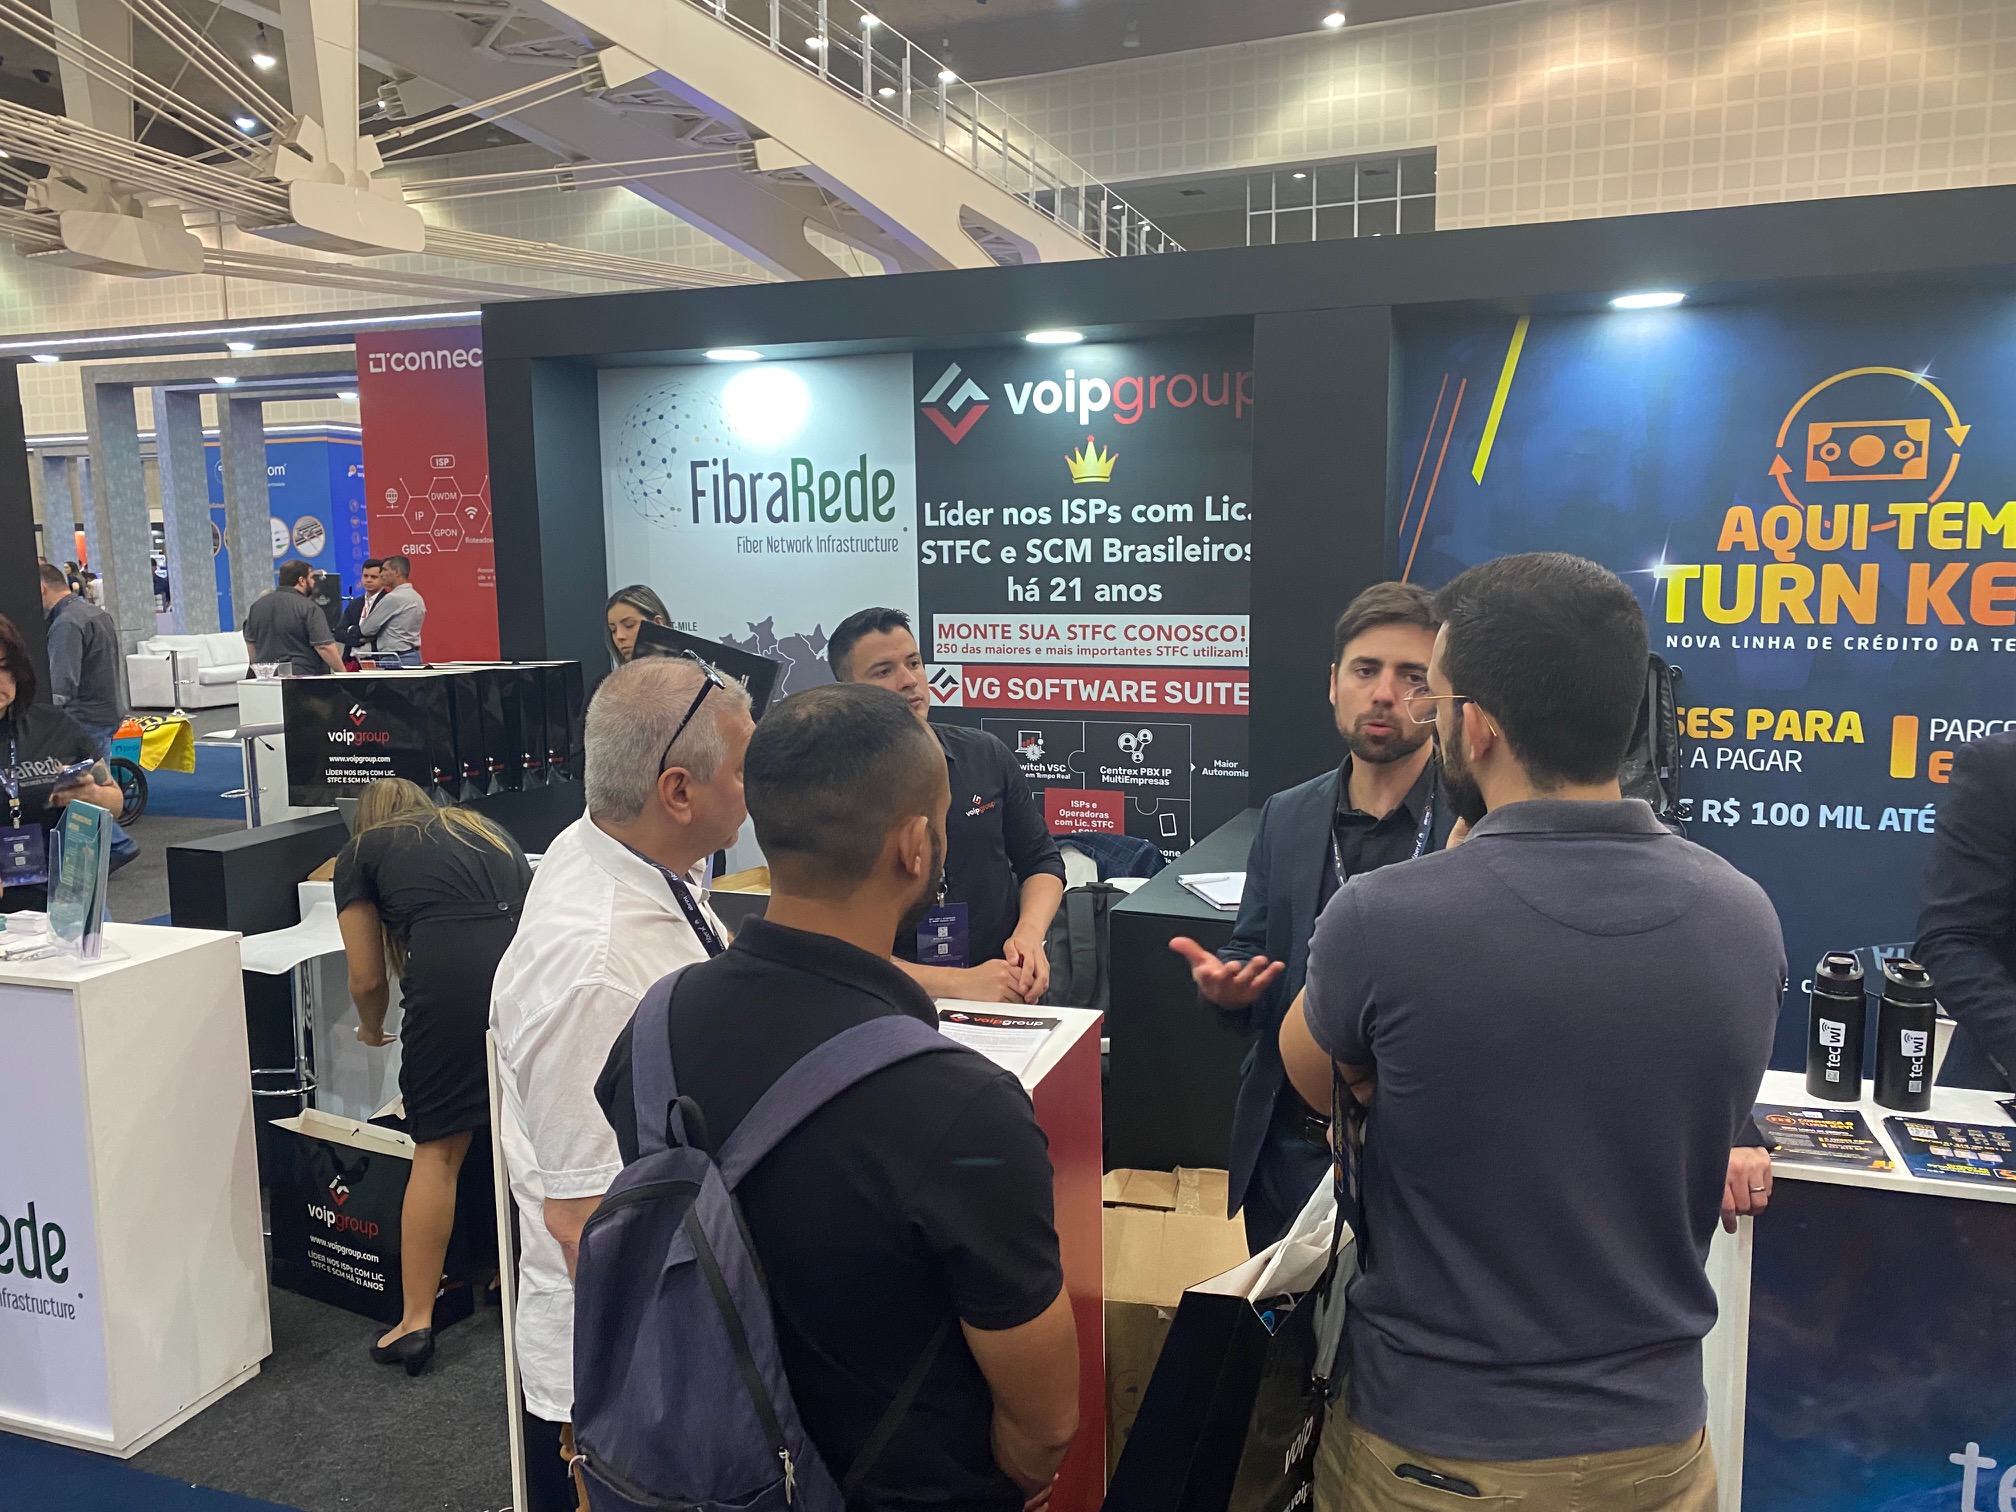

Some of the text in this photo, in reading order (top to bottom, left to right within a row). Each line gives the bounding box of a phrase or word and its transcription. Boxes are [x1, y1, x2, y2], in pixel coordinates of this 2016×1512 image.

[435, 457, 450, 467] ISP
[430, 492, 457, 501] DWDM
[690, 453, 896, 525] FibraRede
[415, 511, 424, 521] IP
[924, 495, 1252, 527] Líder nos ISPs com Lic.
[433, 528, 458, 537] GPON
[1716, 501, 2016, 563] AQUI TEM
[401, 544, 432, 555] GBICS
[737, 534, 899, 553] Fiber Network Infrastructure
[921, 539, 992, 565] STFC
[1000, 546, 1017, 564] e
[1026, 538, 1092, 564] SCM
[1008, 576, 1163, 602] há 21 anos
[1653, 563, 1880, 625] TURN
[938, 623, 1247, 643] MONTE SUA STFC CONOSCO!
[1666, 635, 1721, 649] NOVA
[1731, 635, 1796, 650] LINHA
[1807, 636, 1833, 650] DE
[1844, 633, 1939, 651] CRÉDITO
[1950, 637, 1980, 652] DA
[936, 643, 1249, 659] 250 das maiores e mais importantes STFC utilizam!
[964, 676, 1249, 706] VG SOFTWARE SUITE
[1746, 709, 1865, 744] PARA
[327, 729, 390, 746] voipgroup
[328, 754, 391, 764] www.voipgroup.com
[1213, 760, 1238, 769] Maior
[1690, 747, 1803, 773] A PAGAR
[1047, 764, 1067, 772] VSC
[1099, 766, 1172, 777] Centrex PBX IP
[1201, 767, 1249, 778] Autonomia
[1102, 775, 1170, 786] MultiEmpresas
[1070, 800, 1090, 808] ISPs
[1059, 808, 1110, 819] Operadoras
[1702, 797, 1741, 827] R$
[1751, 801, 1810, 828] 100
[1818, 804, 1871, 831] MIL
[1878, 803, 1936, 834] ATÉ
[1074, 819, 1090, 827] Lic.
[1091, 820, 1114, 829] STFC
[973, 1015, 1044, 1027] voipgroup
[308, 1203, 379, 1238] voipgroup
[309, 1234, 380, 1263] www.voipgroup.com
[354, 1266, 370, 1279] COM
[371, 1272, 386, 1282] LIC.
[362, 1278, 385, 1291] ANOS
